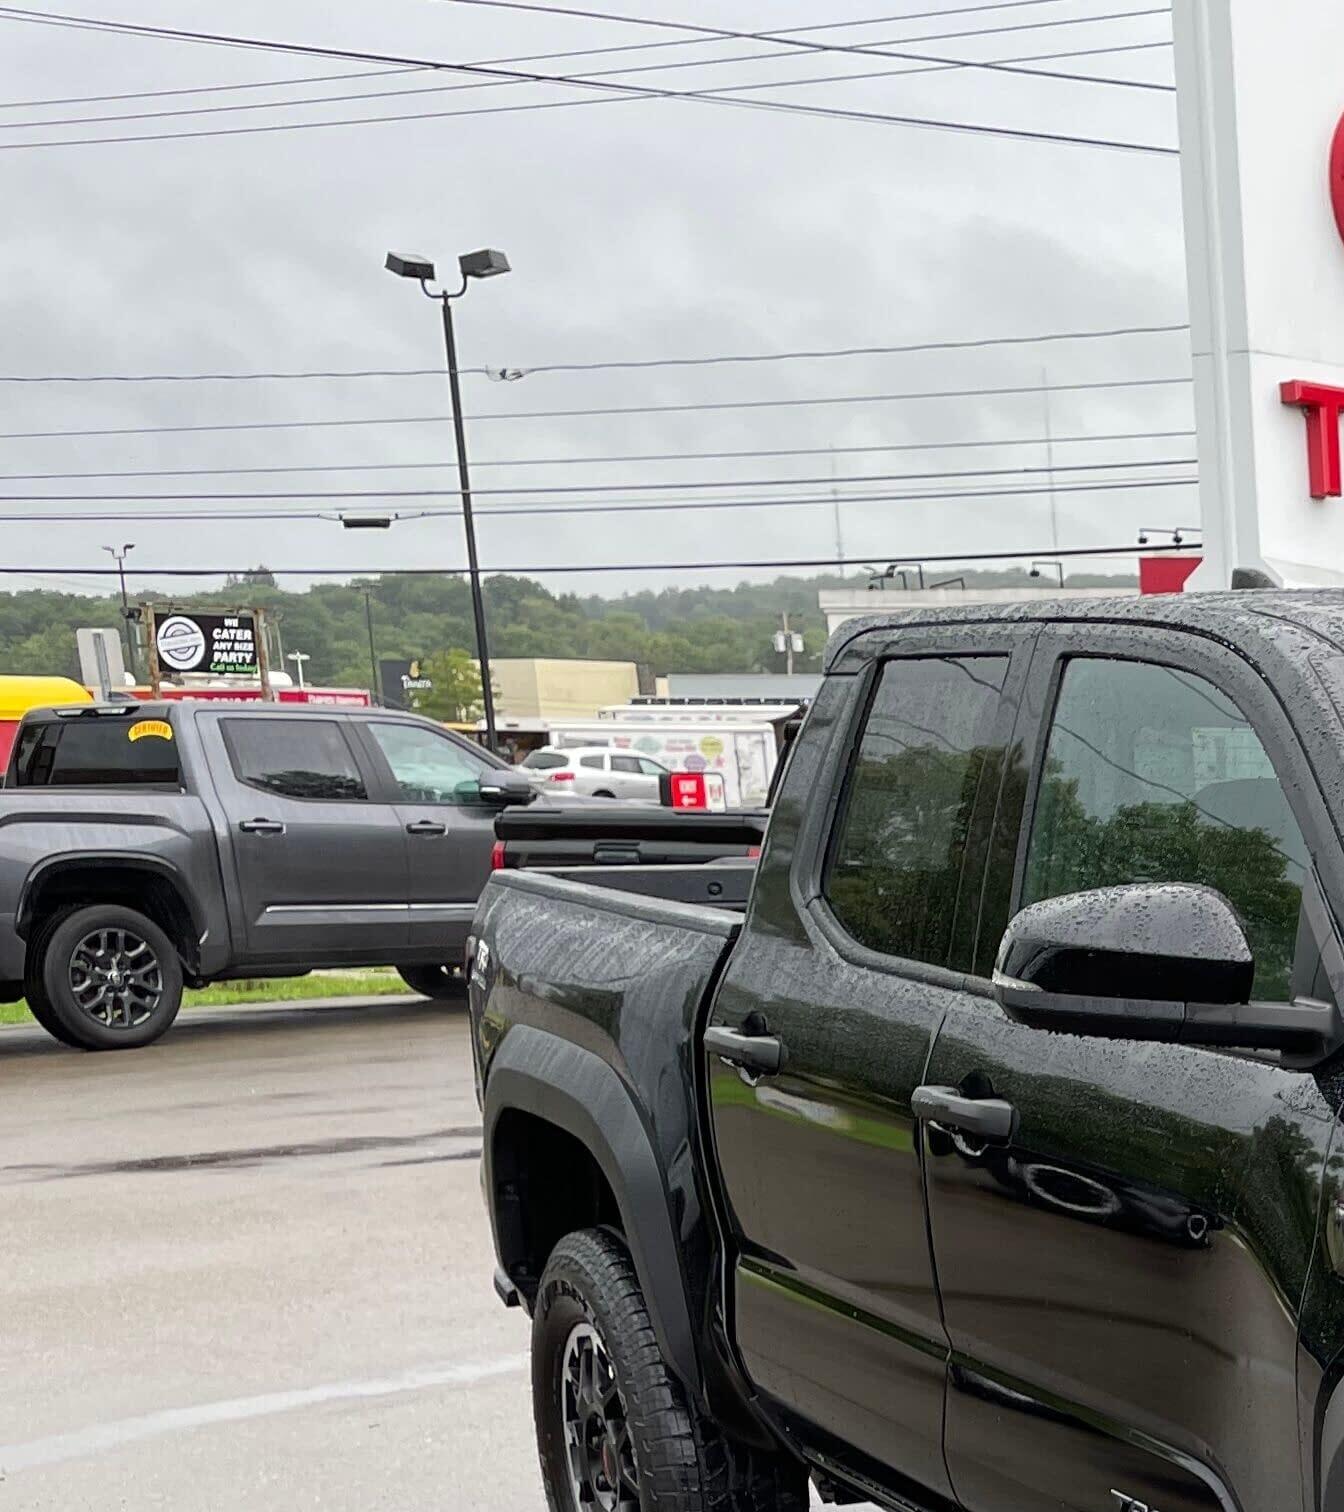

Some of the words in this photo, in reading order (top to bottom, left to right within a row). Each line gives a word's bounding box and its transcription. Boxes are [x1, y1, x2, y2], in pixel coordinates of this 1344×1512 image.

[212, 628, 252, 641] CATER
[212, 641, 233, 651] ANY
[213, 651, 253, 664] PARTY
